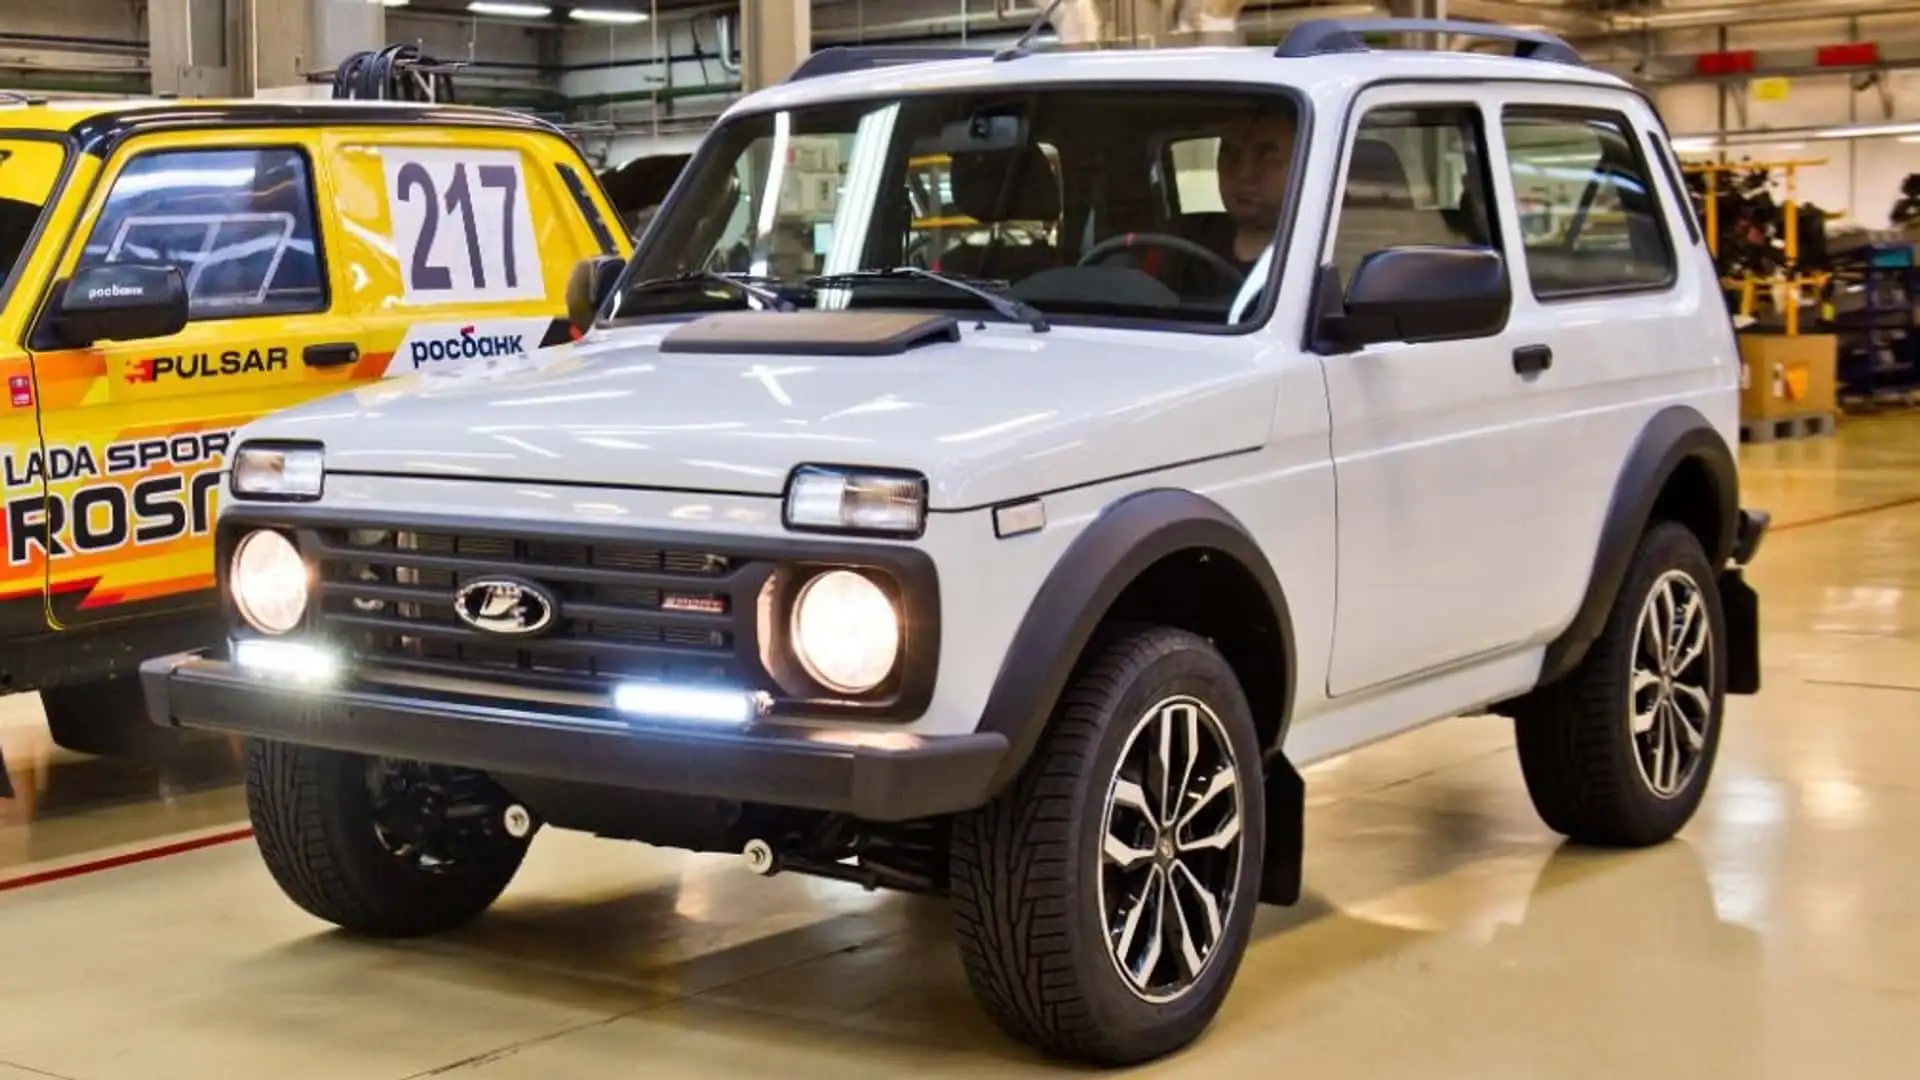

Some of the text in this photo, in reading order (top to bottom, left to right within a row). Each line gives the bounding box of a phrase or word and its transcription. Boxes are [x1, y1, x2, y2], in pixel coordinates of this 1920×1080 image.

[397, 161, 518, 290] 217
[151, 347, 288, 382] PULSAR
[410, 325, 525, 369] росбанк
[4, 430, 236, 486] LADA SPOR
